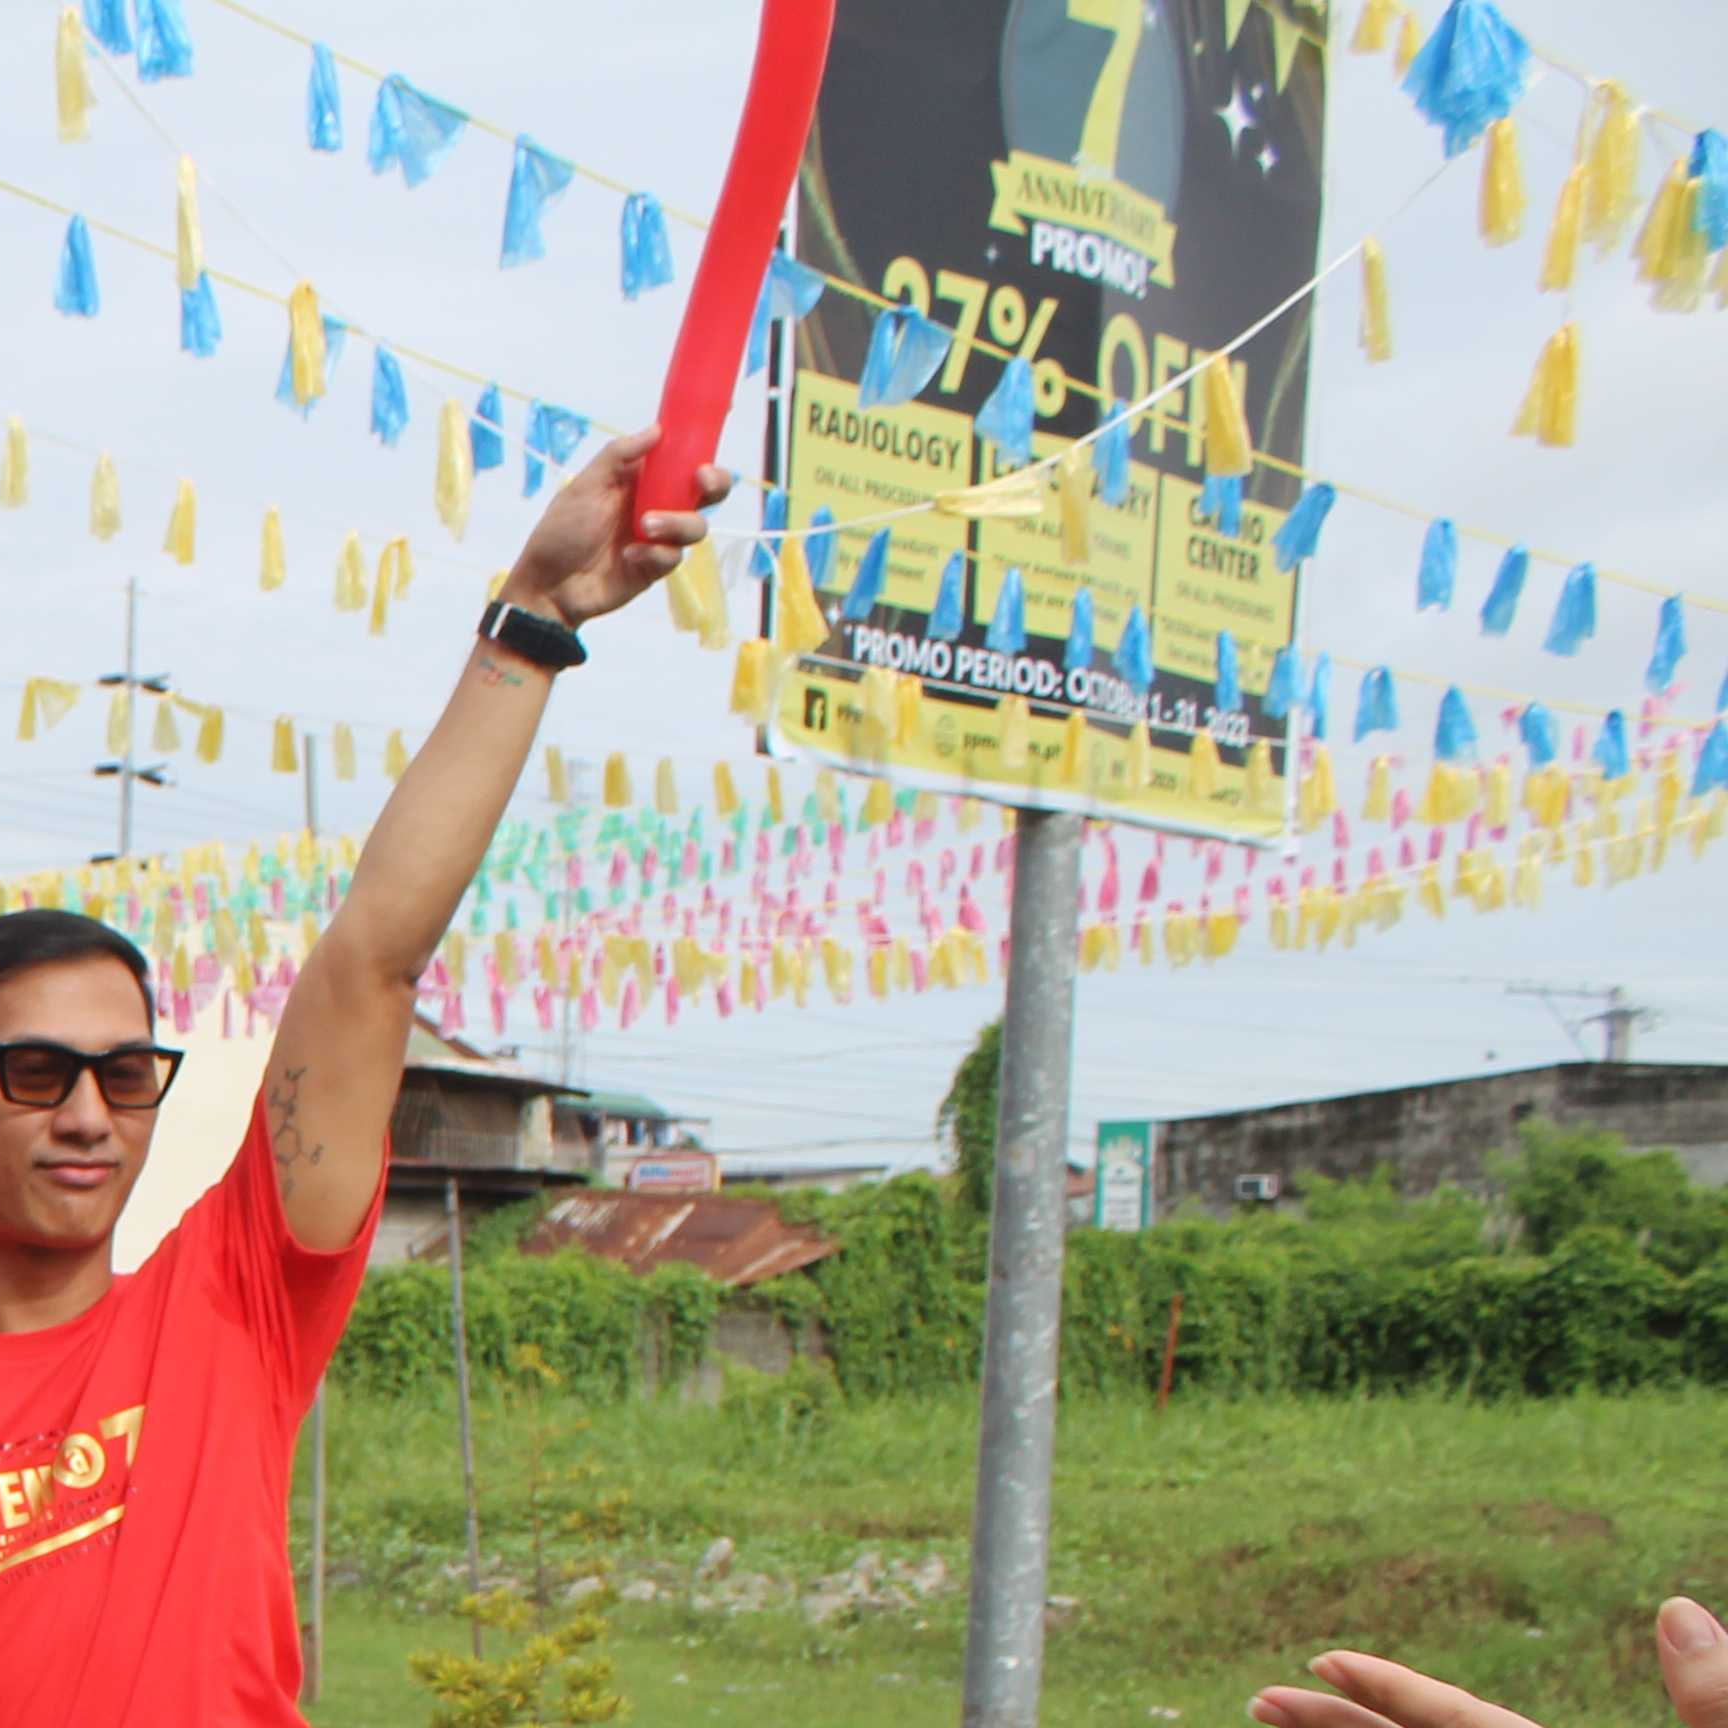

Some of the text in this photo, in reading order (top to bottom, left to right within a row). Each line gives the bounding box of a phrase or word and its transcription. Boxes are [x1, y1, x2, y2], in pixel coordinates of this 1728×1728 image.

[808, 402, 964, 471] RADIOLOGY
[1187, 534, 1260, 582] CENTER
[954, 646, 1065, 699] PERIOD:
